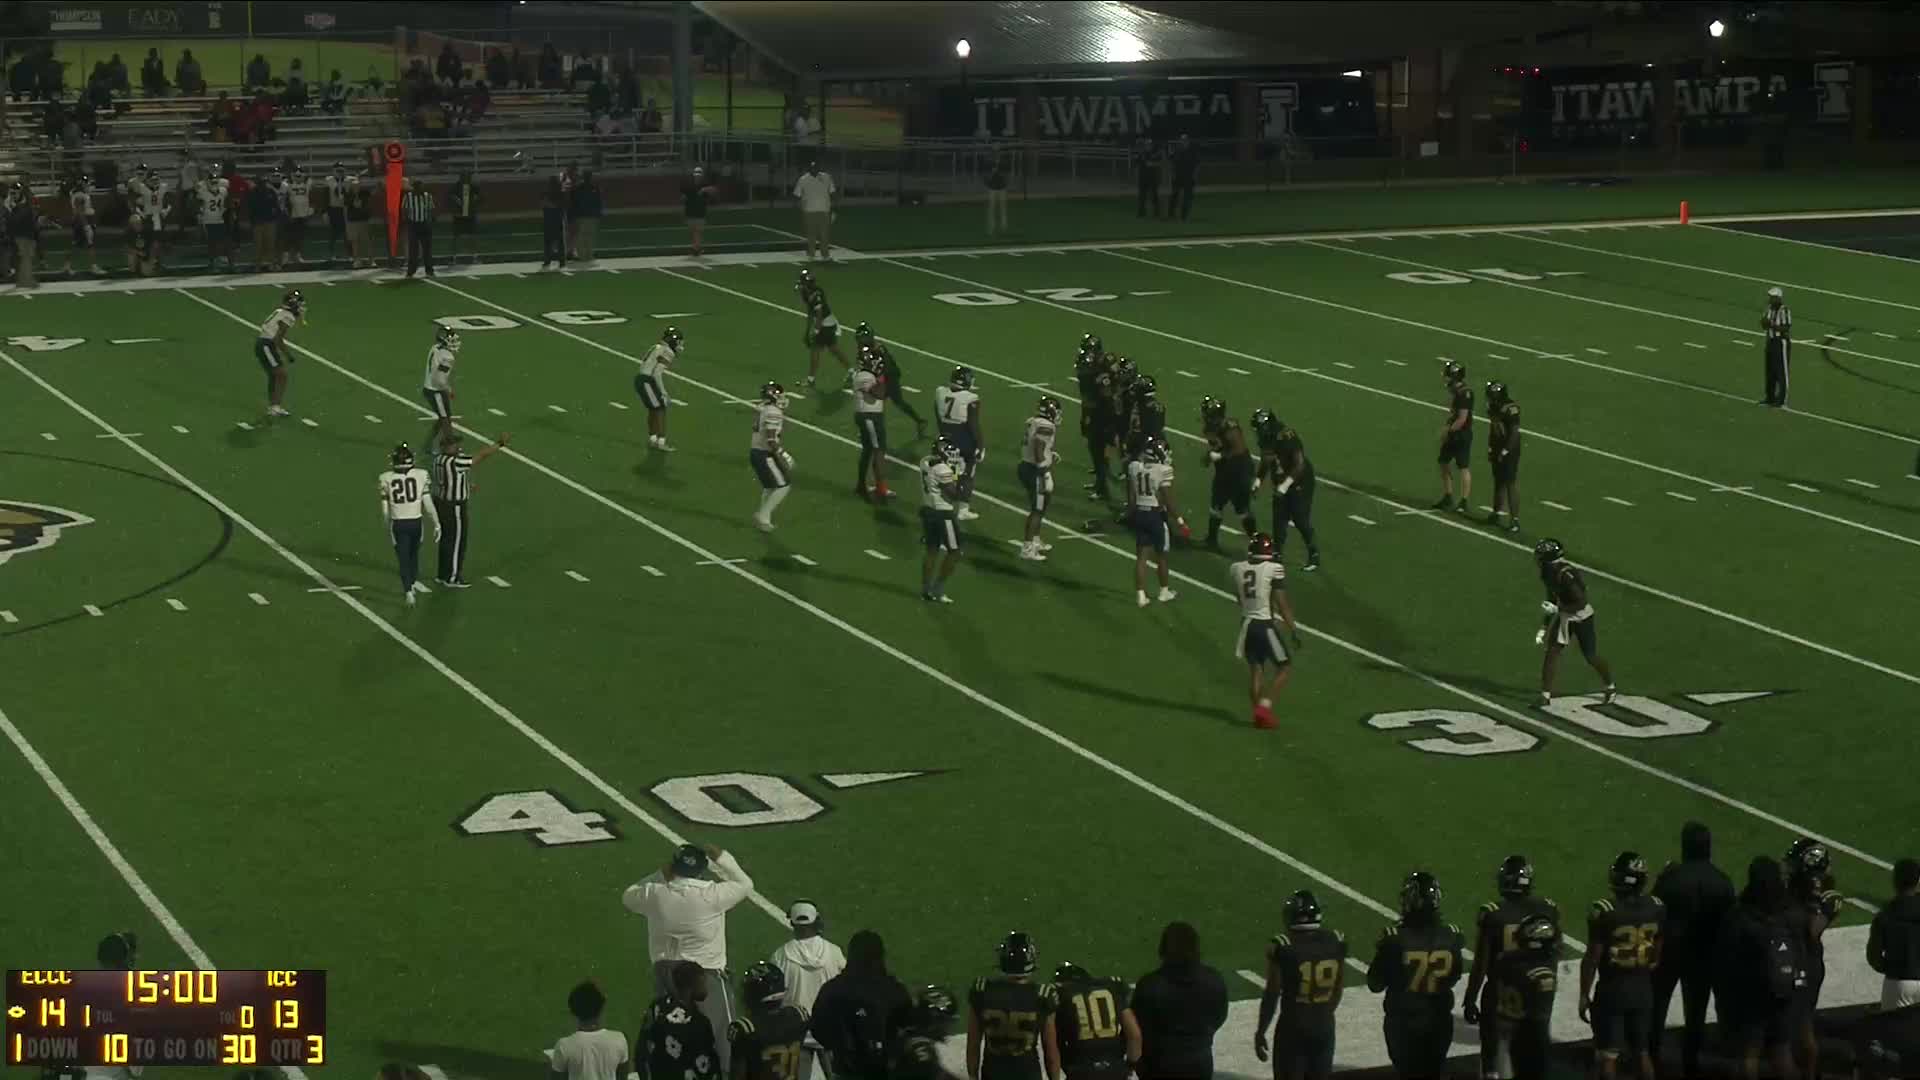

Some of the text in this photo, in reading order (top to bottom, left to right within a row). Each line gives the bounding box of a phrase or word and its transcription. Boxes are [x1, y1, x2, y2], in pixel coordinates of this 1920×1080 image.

[944, 396, 956, 419] 7
[391, 477, 418, 504] 20
[1136, 472, 1152, 497] 11
[1243, 570, 1257, 599] 2
[1297, 960, 1340, 1004] 19
[1404, 950, 1454, 993] 72
[1072, 989, 1119, 1041] 10
